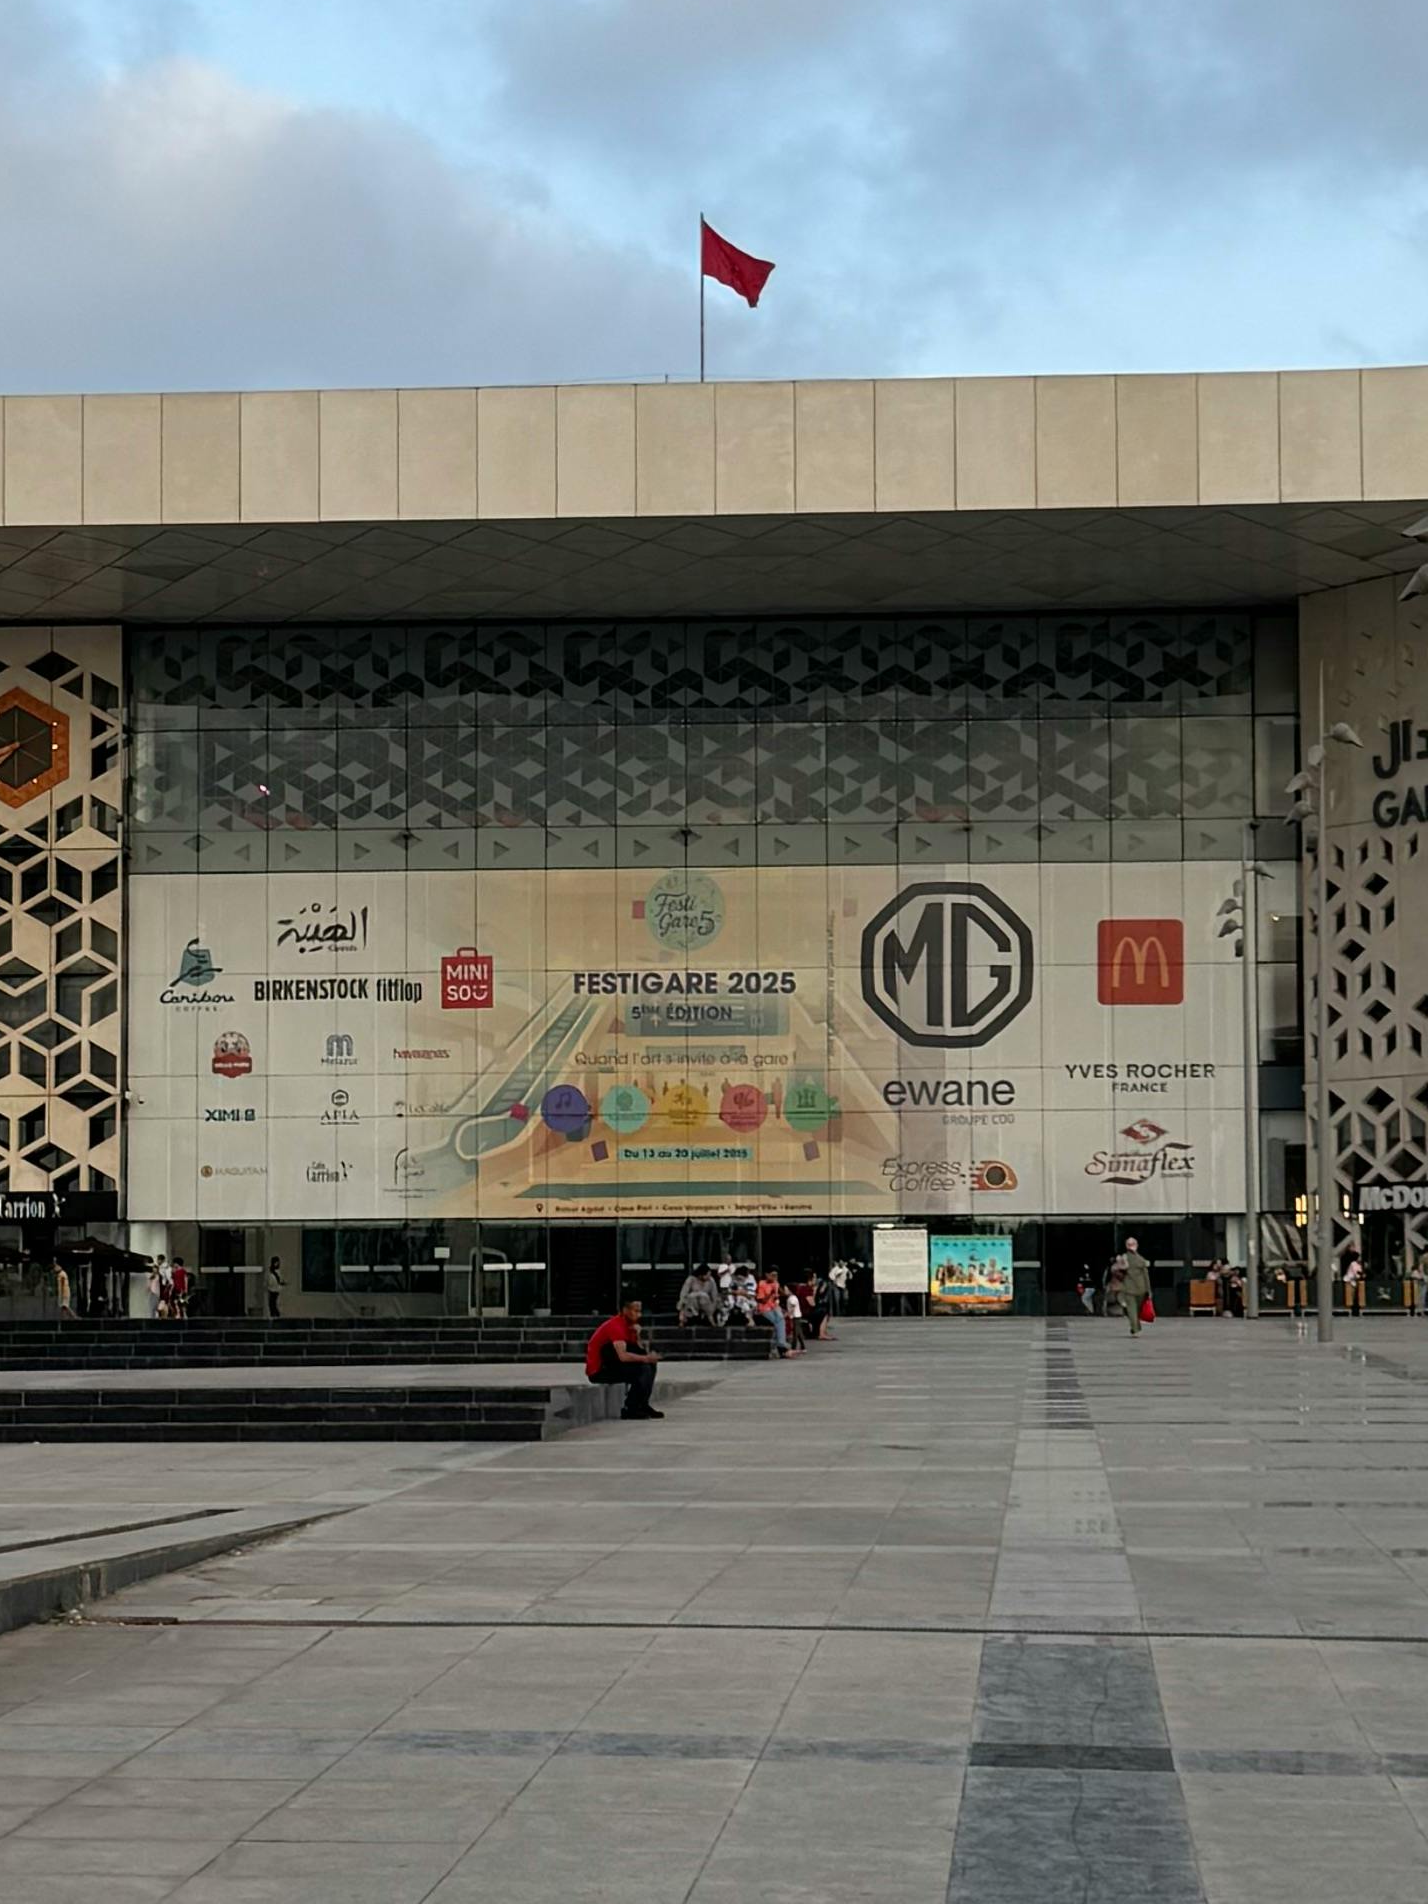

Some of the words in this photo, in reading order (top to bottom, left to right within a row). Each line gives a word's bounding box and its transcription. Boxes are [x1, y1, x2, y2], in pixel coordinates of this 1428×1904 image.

[446, 963, 489, 982] MINI
[882, 902, 1012, 1027] MG
[254, 978, 369, 1001] BIRKENSTOCK
[376, 978, 422, 1003] fitflop
[573, 972, 718, 995] FESTIGARE
[727, 972, 797, 995] 2025
[160, 989, 235, 1005] Caribou
[666, 1002, 733, 1021] ÉDITION
[575, 1051, 629, 1066] Quand
[753, 1054, 789, 1069] gare
[1065, 1063, 1118, 1079] YVES
[1126, 1063, 1216, 1079] ROCHER
[883, 1080, 1015, 1105] ewane
[1111, 1082, 1168, 1093] FRANCE
